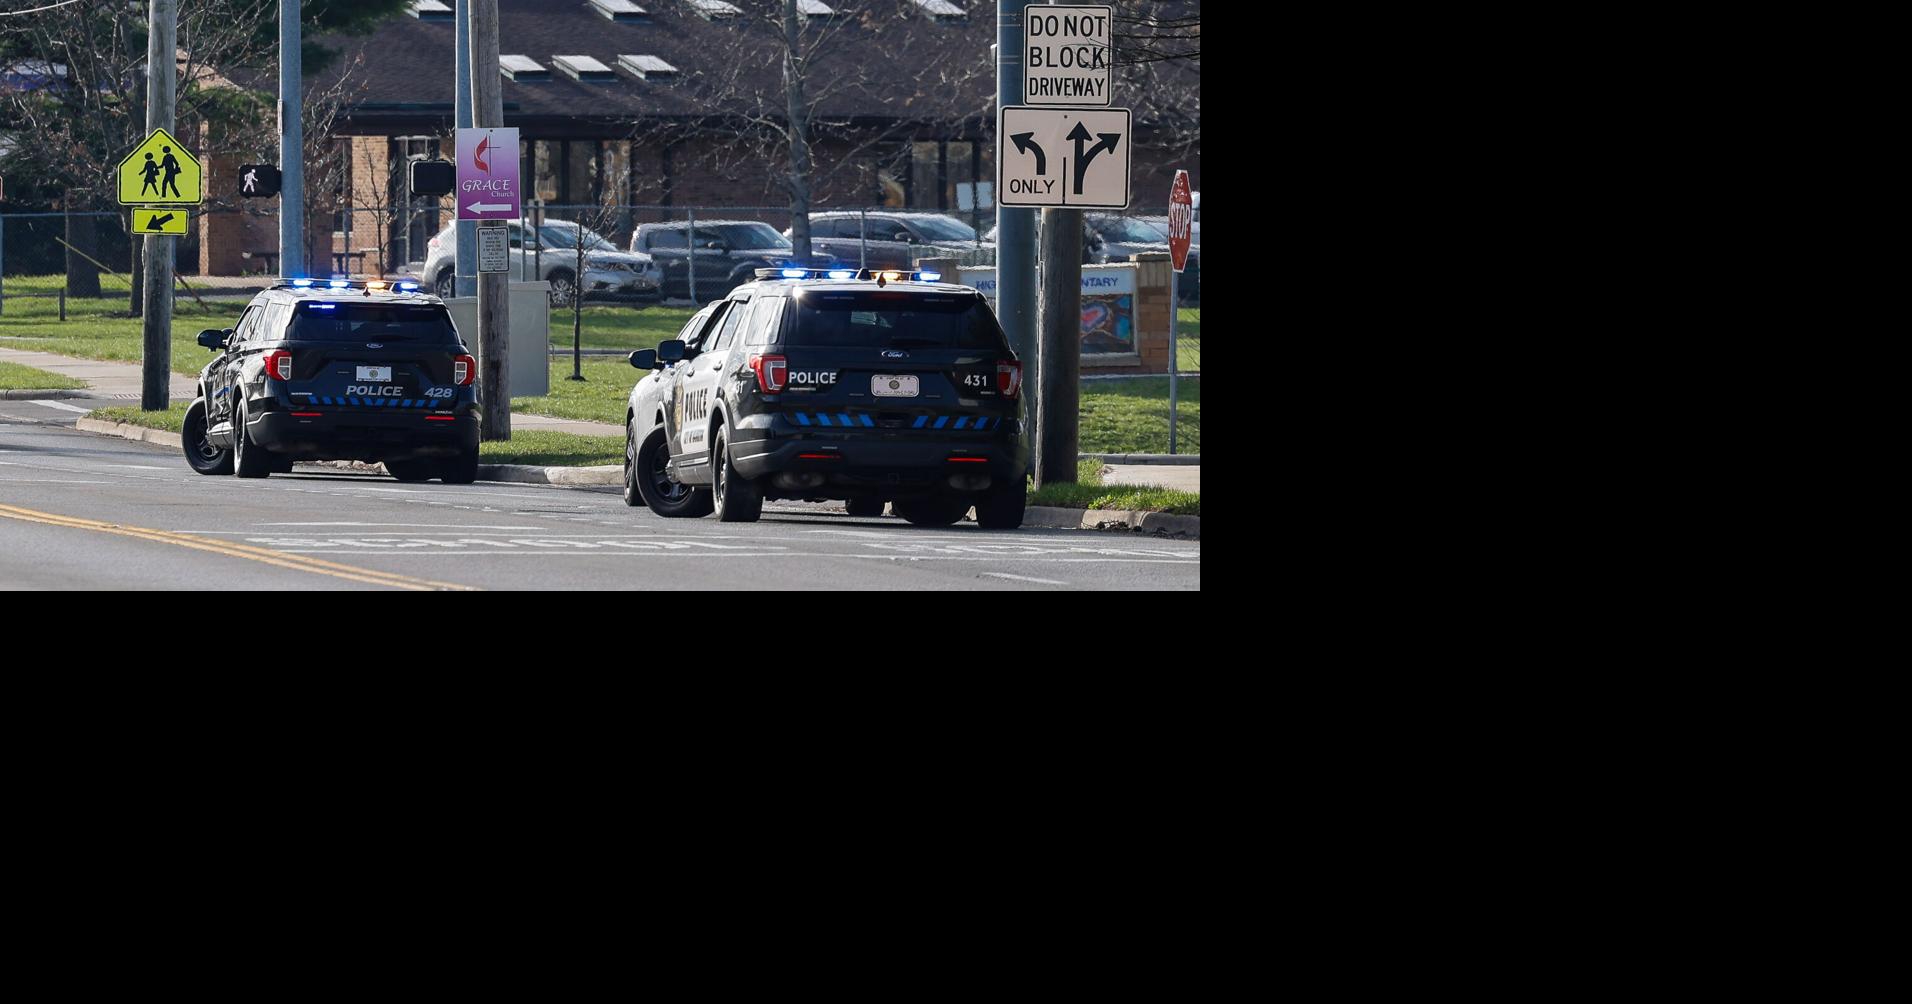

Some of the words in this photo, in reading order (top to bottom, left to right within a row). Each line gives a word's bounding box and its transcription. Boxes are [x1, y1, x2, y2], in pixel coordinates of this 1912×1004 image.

[1030, 15, 1059, 37] DO
[1063, 15, 1106, 37] NOT
[1029, 46, 1105, 69] BLOCK
[1029, 77, 1105, 97] DRIVEWAY
[462, 179, 511, 193] GRACE
[1009, 178, 1055, 194] ONLY
[491, 190, 515, 198] Church
[1169, 201, 1191, 239] STOP
[788, 371, 837, 384] POLICE
[964, 375, 988, 387] 431
[346, 385, 404, 397] POLICE
[424, 387, 453, 398] 428
[685, 388, 708, 422] POLICE
